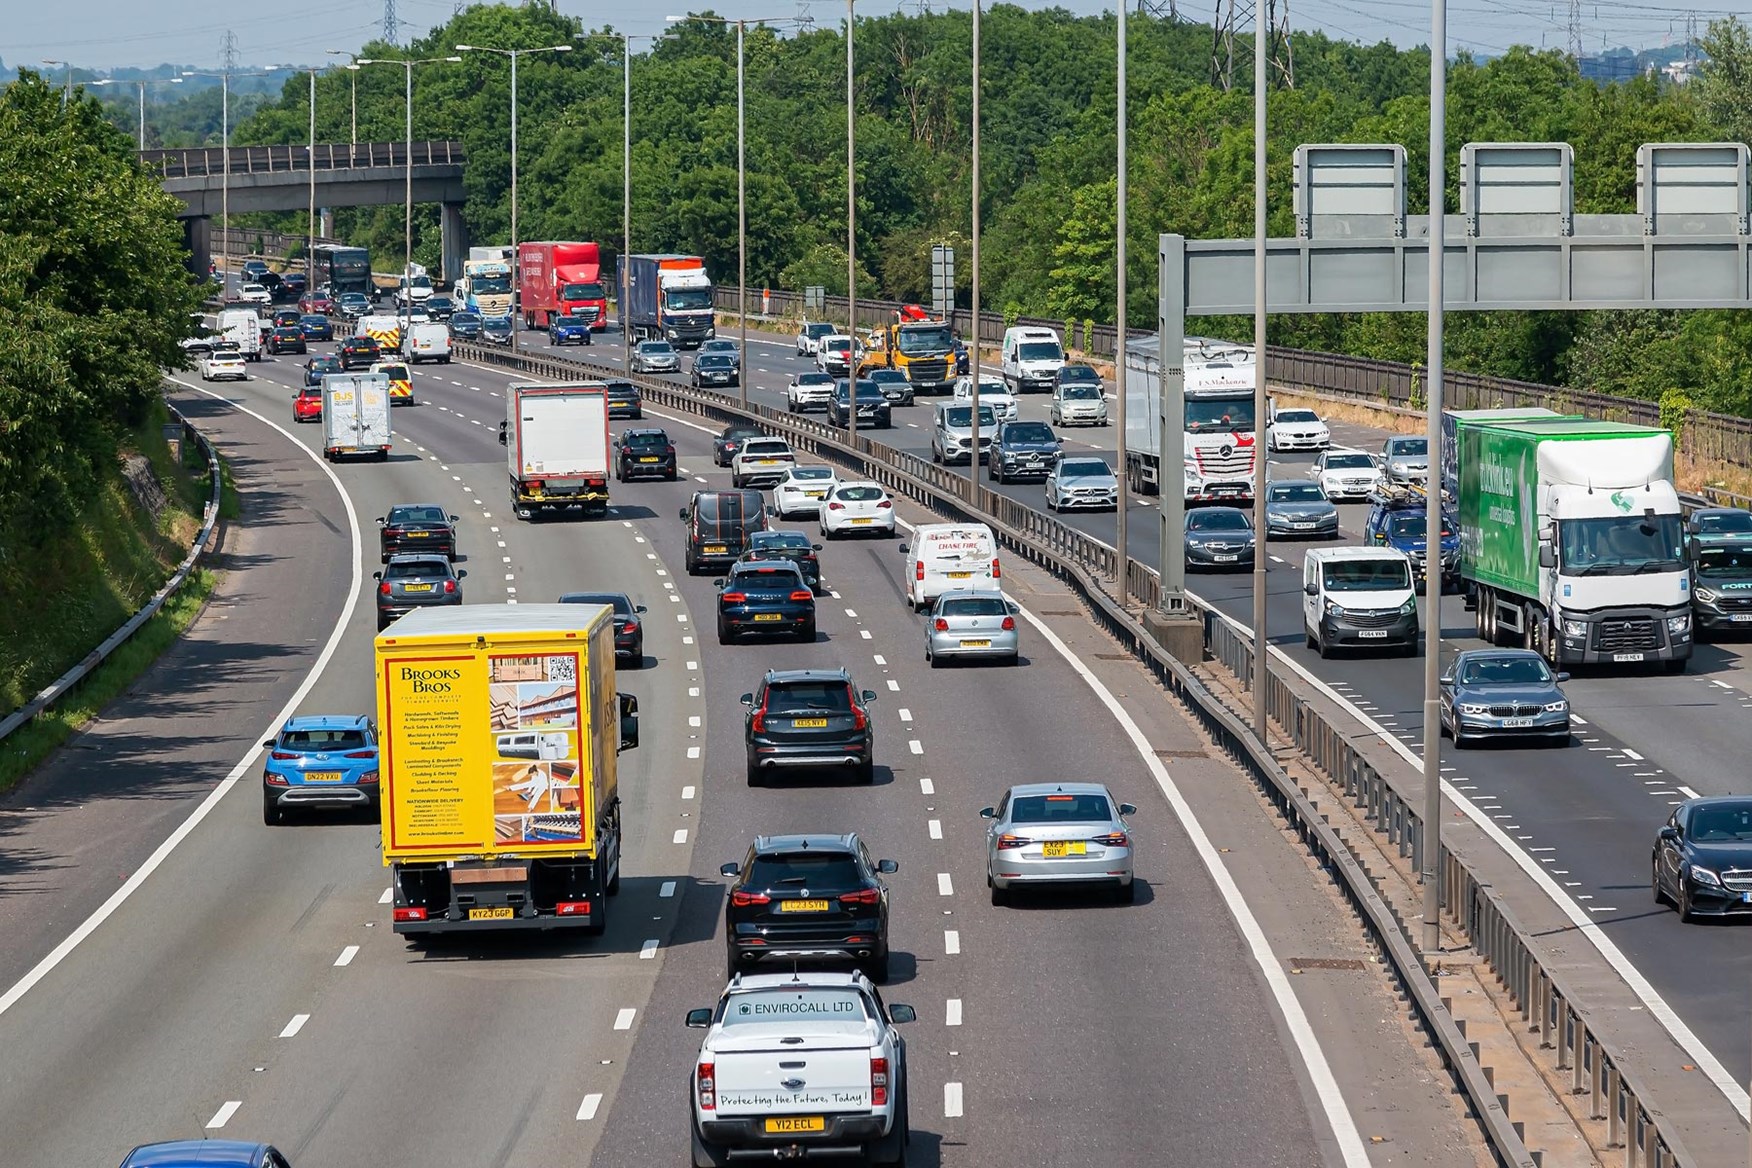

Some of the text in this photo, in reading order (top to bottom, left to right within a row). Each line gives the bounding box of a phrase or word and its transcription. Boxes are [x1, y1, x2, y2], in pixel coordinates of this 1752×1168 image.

[334, 392, 353, 400] BJS
[401, 667, 461, 682] BROOKS
[413, 680, 451, 694] BROS
[472, 910, 493, 918] KY23
[755, 1002, 854, 1014] ENVIROCALL LTD
[720, 1093, 772, 1108] Protecting
[776, 1094, 791, 1104] the
[793, 1093, 828, 1104] Future,
[775, 1119, 814, 1130] Y12 ECL
